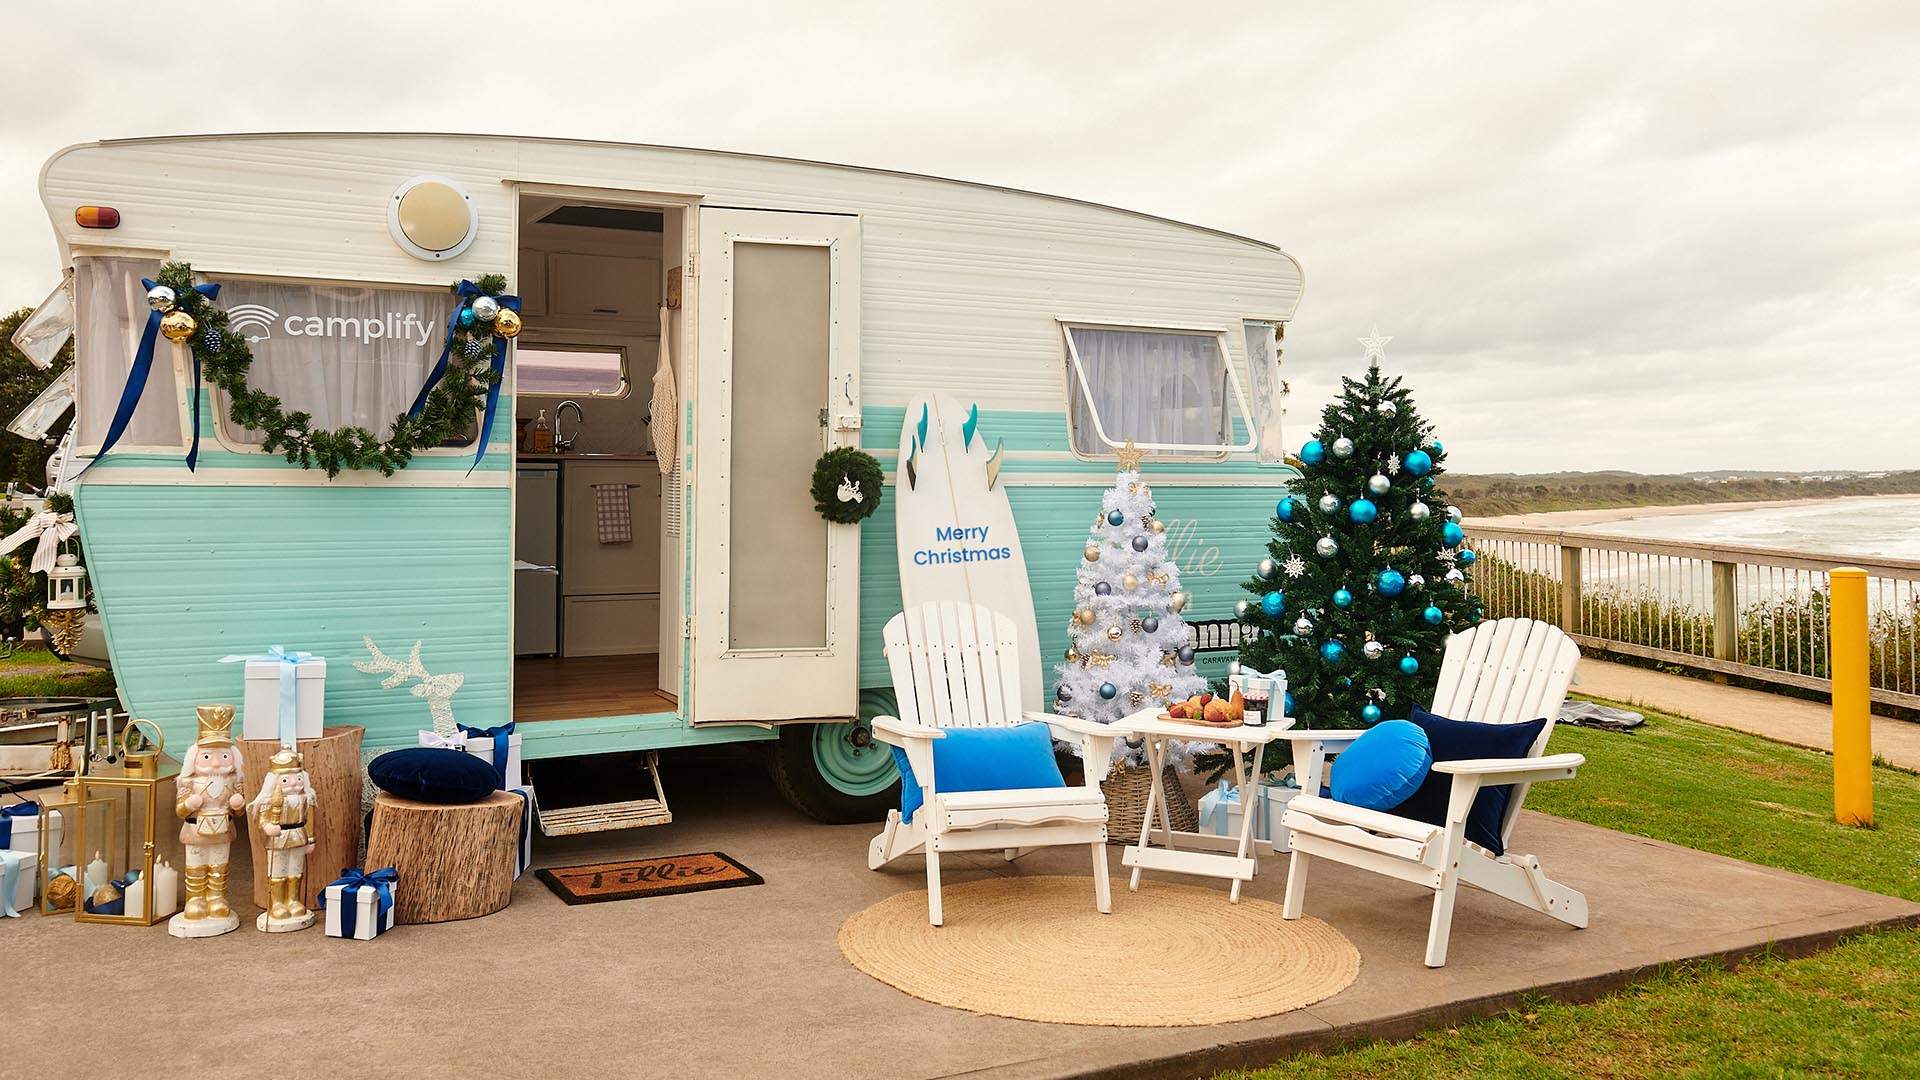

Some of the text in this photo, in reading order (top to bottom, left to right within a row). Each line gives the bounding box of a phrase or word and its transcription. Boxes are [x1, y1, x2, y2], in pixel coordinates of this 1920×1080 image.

[284, 312, 434, 346] camplify
[936, 525, 989, 543] Merry
[1165, 518, 1224, 577] llie
[913, 546, 1011, 566] Christmas
[560, 862, 728, 889] Tillie
